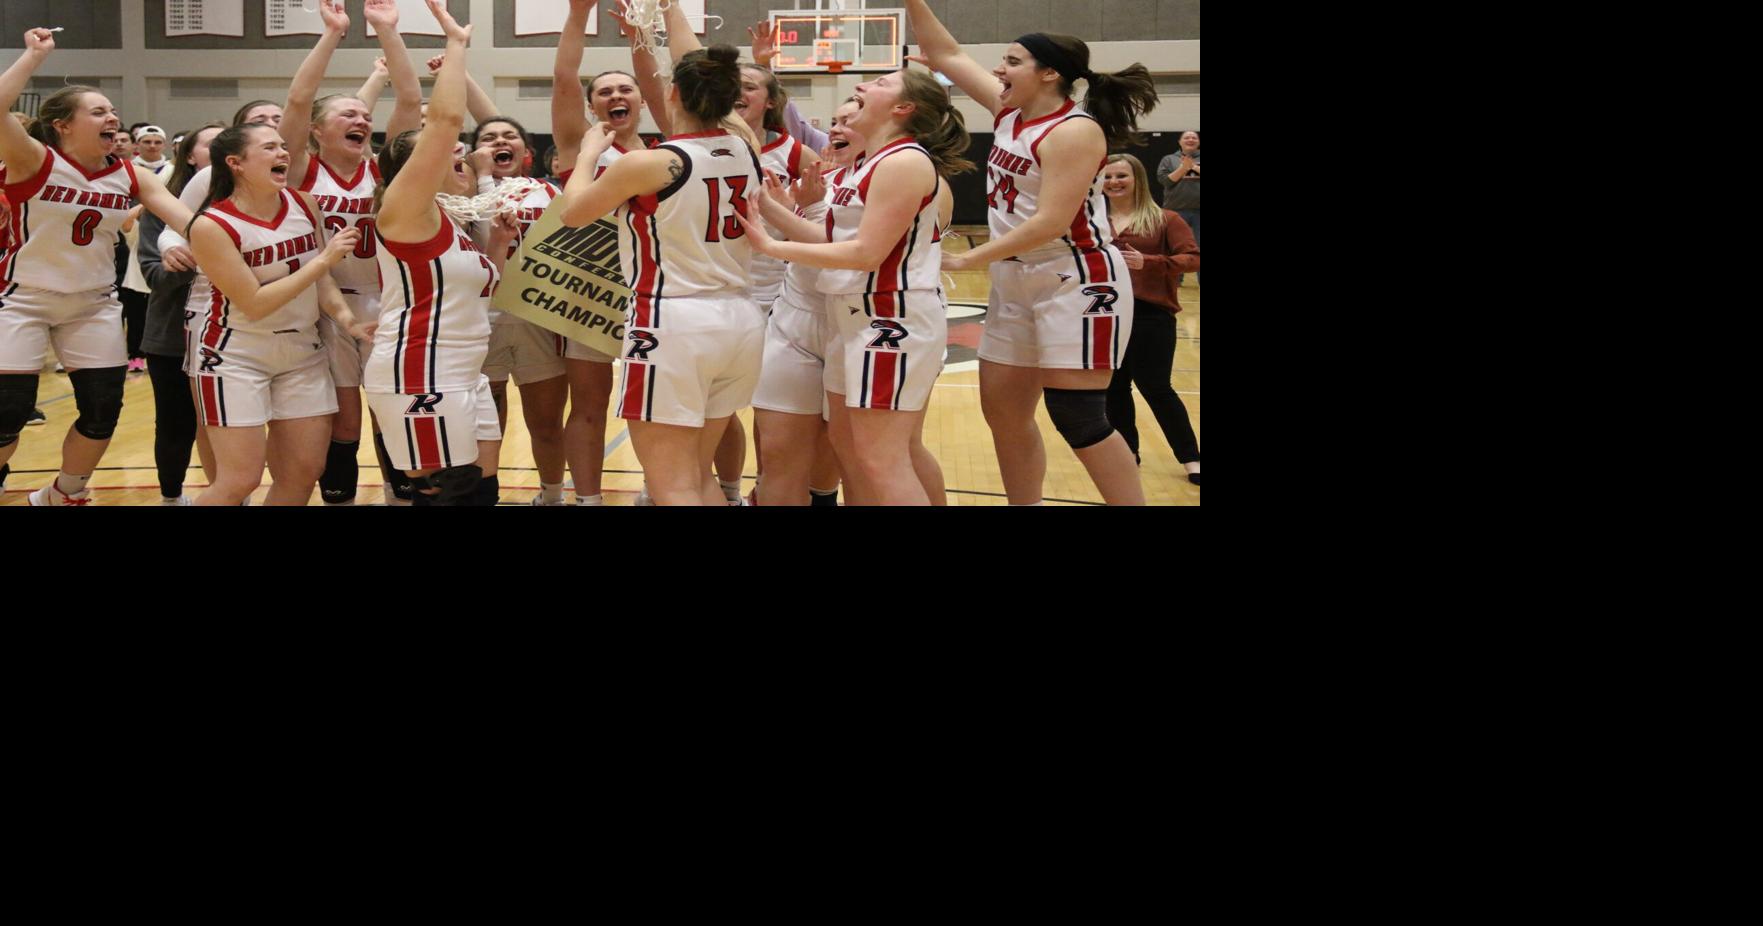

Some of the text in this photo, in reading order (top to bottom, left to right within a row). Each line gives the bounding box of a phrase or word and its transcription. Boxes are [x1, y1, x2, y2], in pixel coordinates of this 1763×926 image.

[40, 185, 77, 203] RED
[702, 175, 747, 242] 13
[72, 209, 103, 246] 0
